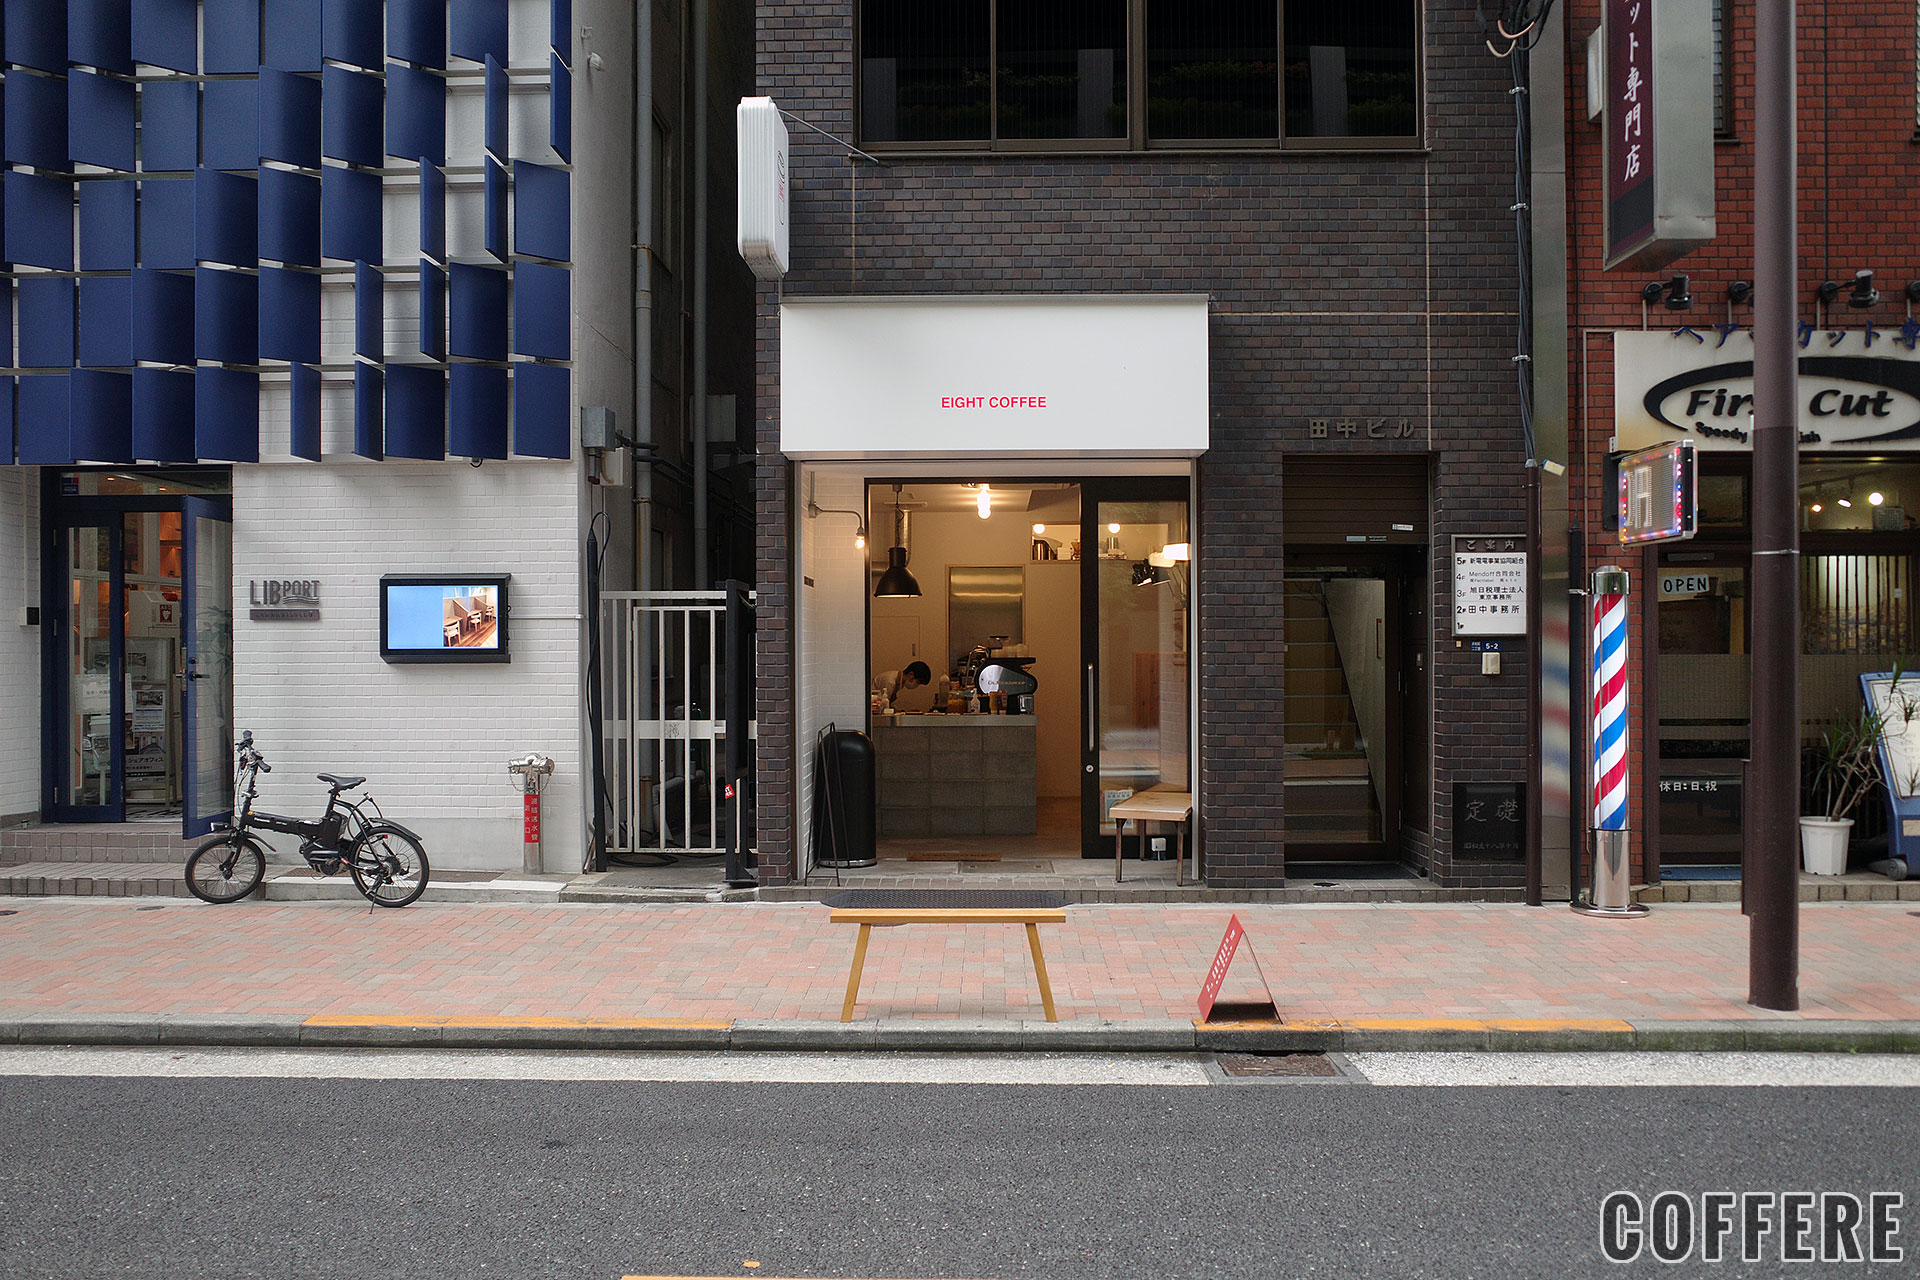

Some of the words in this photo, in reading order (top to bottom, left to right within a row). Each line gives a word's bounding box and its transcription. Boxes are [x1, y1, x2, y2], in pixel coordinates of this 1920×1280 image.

[1623, 0, 1643, 182] ット専門店
[941, 396, 985, 408] EIGHT
[989, 396, 1047, 408] COFFEE
[1809, 388, 1894, 416] Cut
[1309, 418, 1414, 438] 田中ビル
[1695, 421, 1748, 443] Speedy
[1466, 539, 1515, 550] ご案内
[1663, 577, 1707, 592] OPEN
[1468, 605, 1519, 613] 田中事務所
[1465, 800, 1520, 822] 定礎
